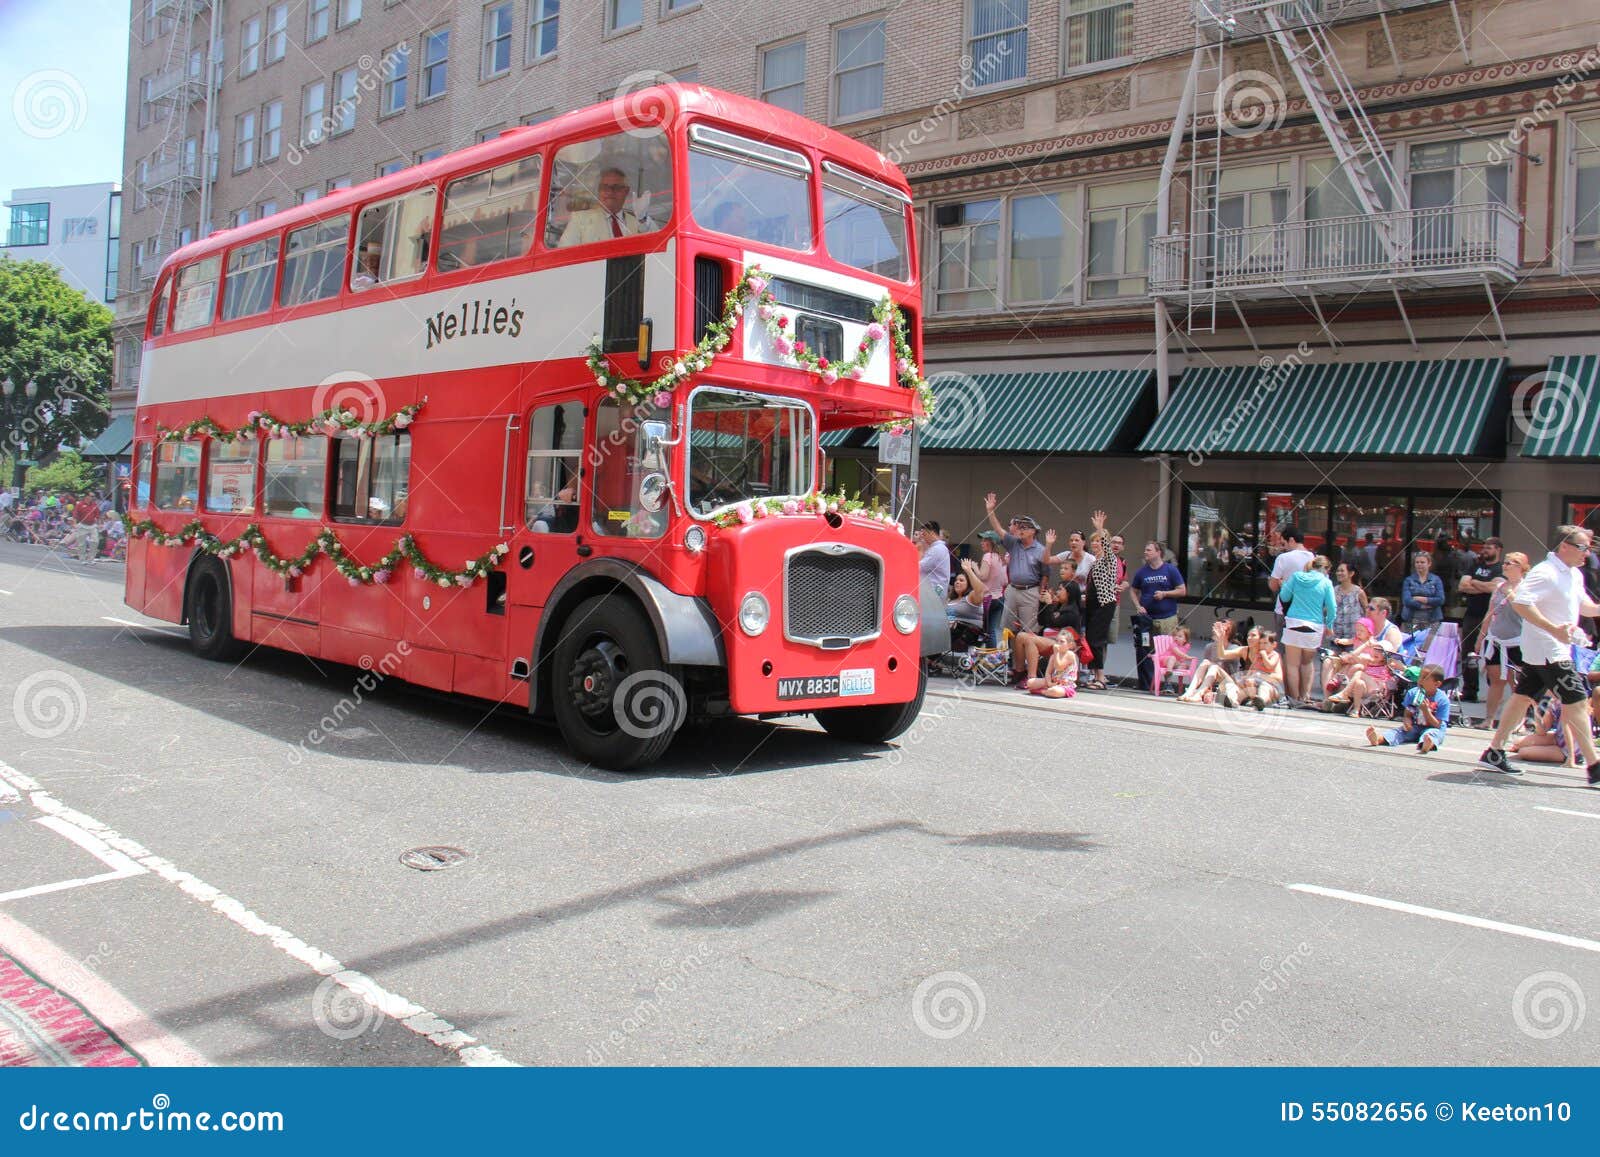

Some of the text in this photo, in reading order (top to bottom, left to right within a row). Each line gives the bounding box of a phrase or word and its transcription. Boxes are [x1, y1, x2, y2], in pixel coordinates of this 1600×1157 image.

[426, 298, 524, 350] Nellie's
[779, 678, 839, 697] MVX 883C
